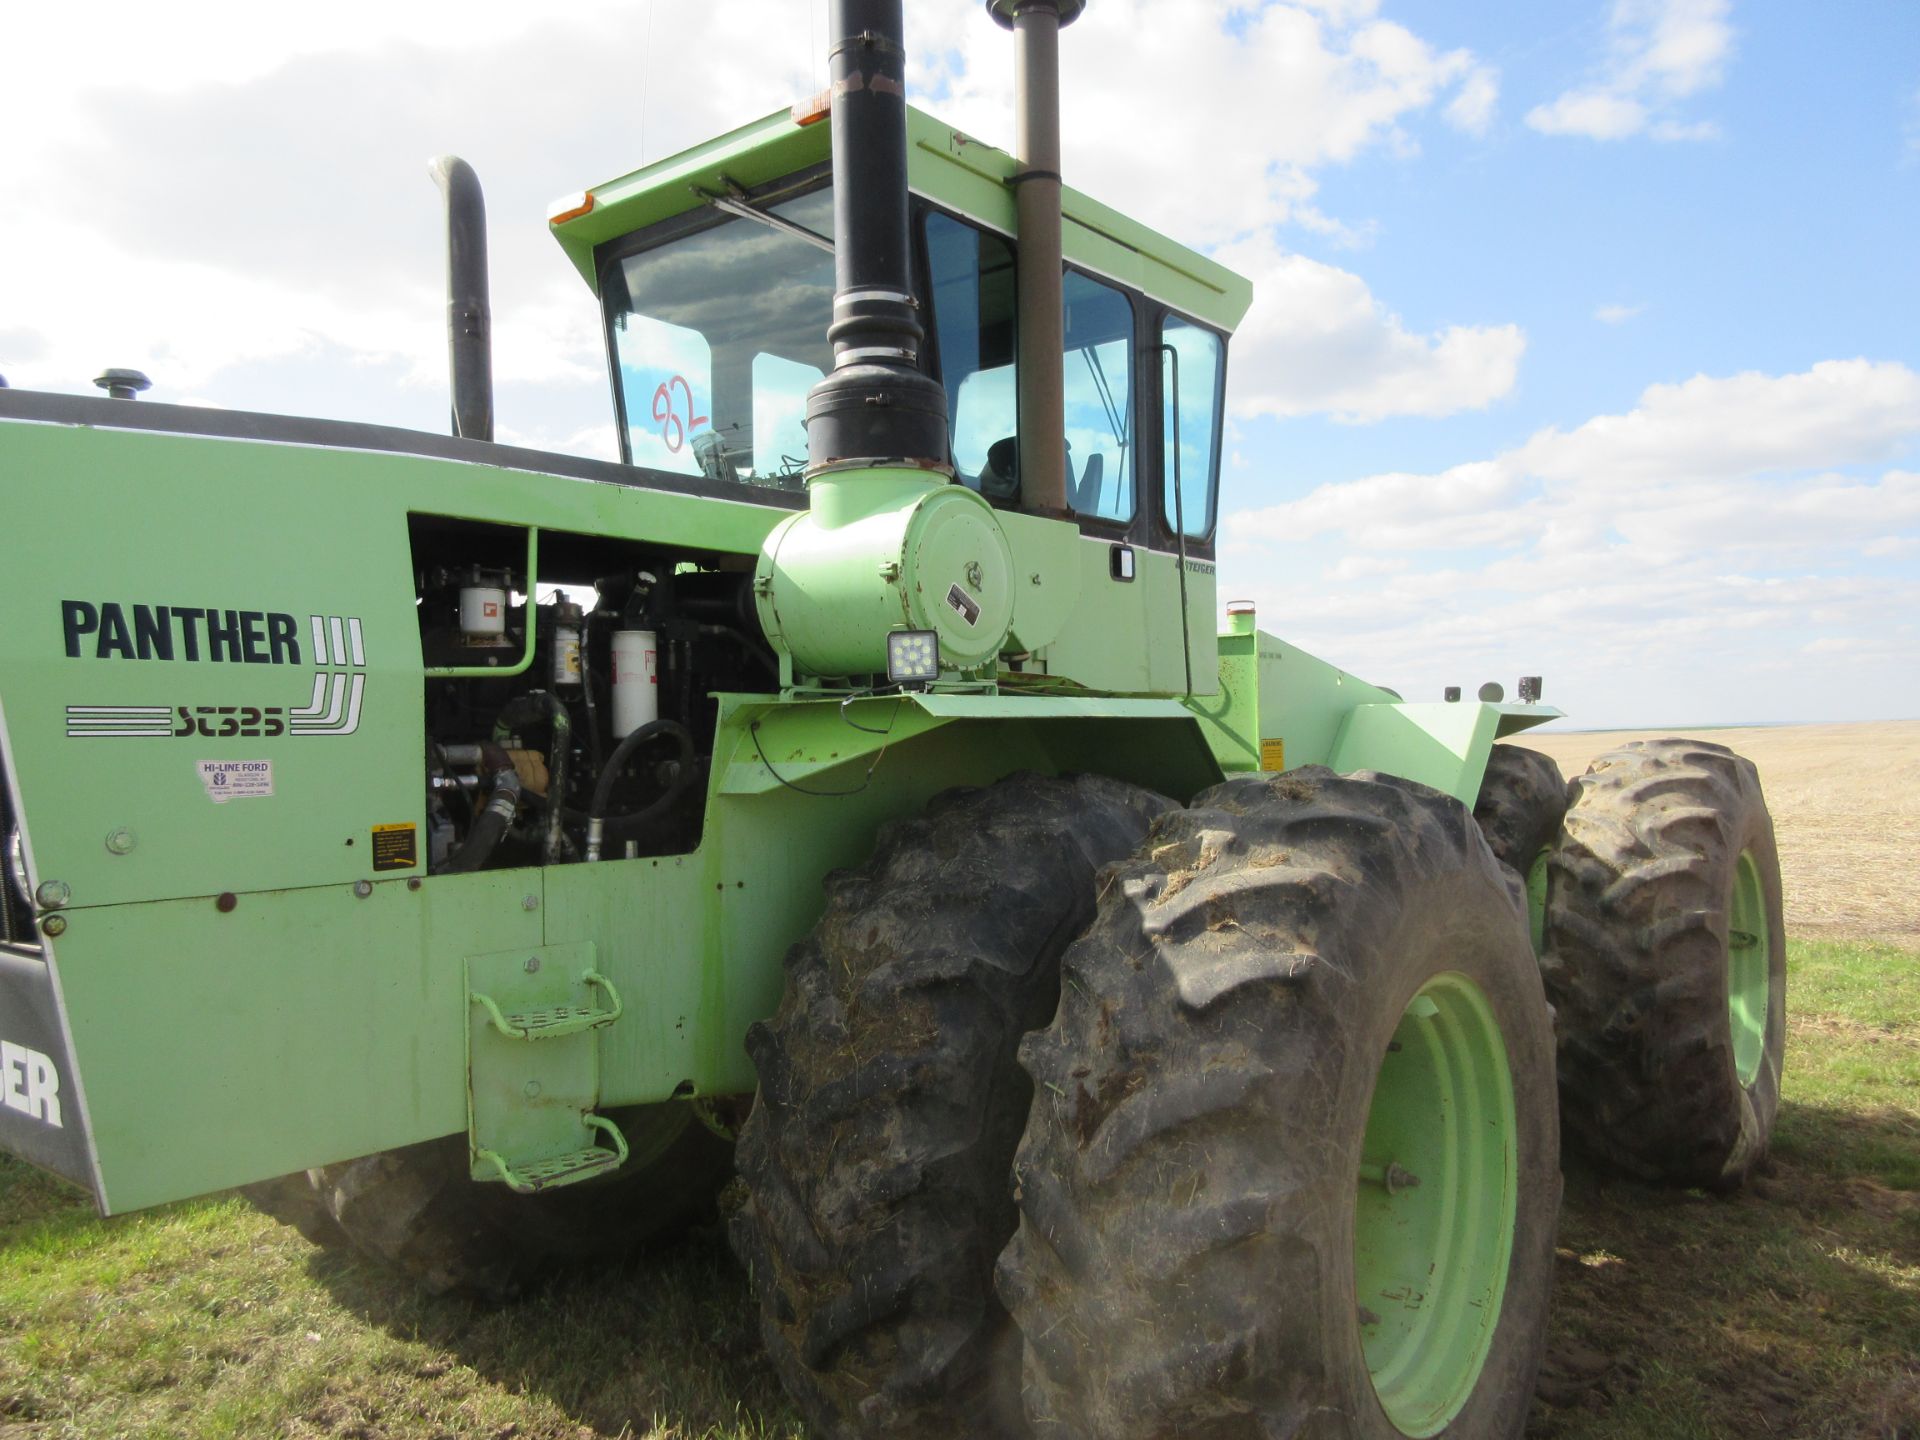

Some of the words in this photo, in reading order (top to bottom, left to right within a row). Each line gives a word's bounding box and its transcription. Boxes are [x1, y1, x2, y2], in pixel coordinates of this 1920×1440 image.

[652, 375, 709, 454] 82
[61, 600, 301, 665] PANTHER
[204, 763, 241, 772] HI-LINE
[242, 763, 268, 771] FORD
[0, 1040, 63, 1128] ER
